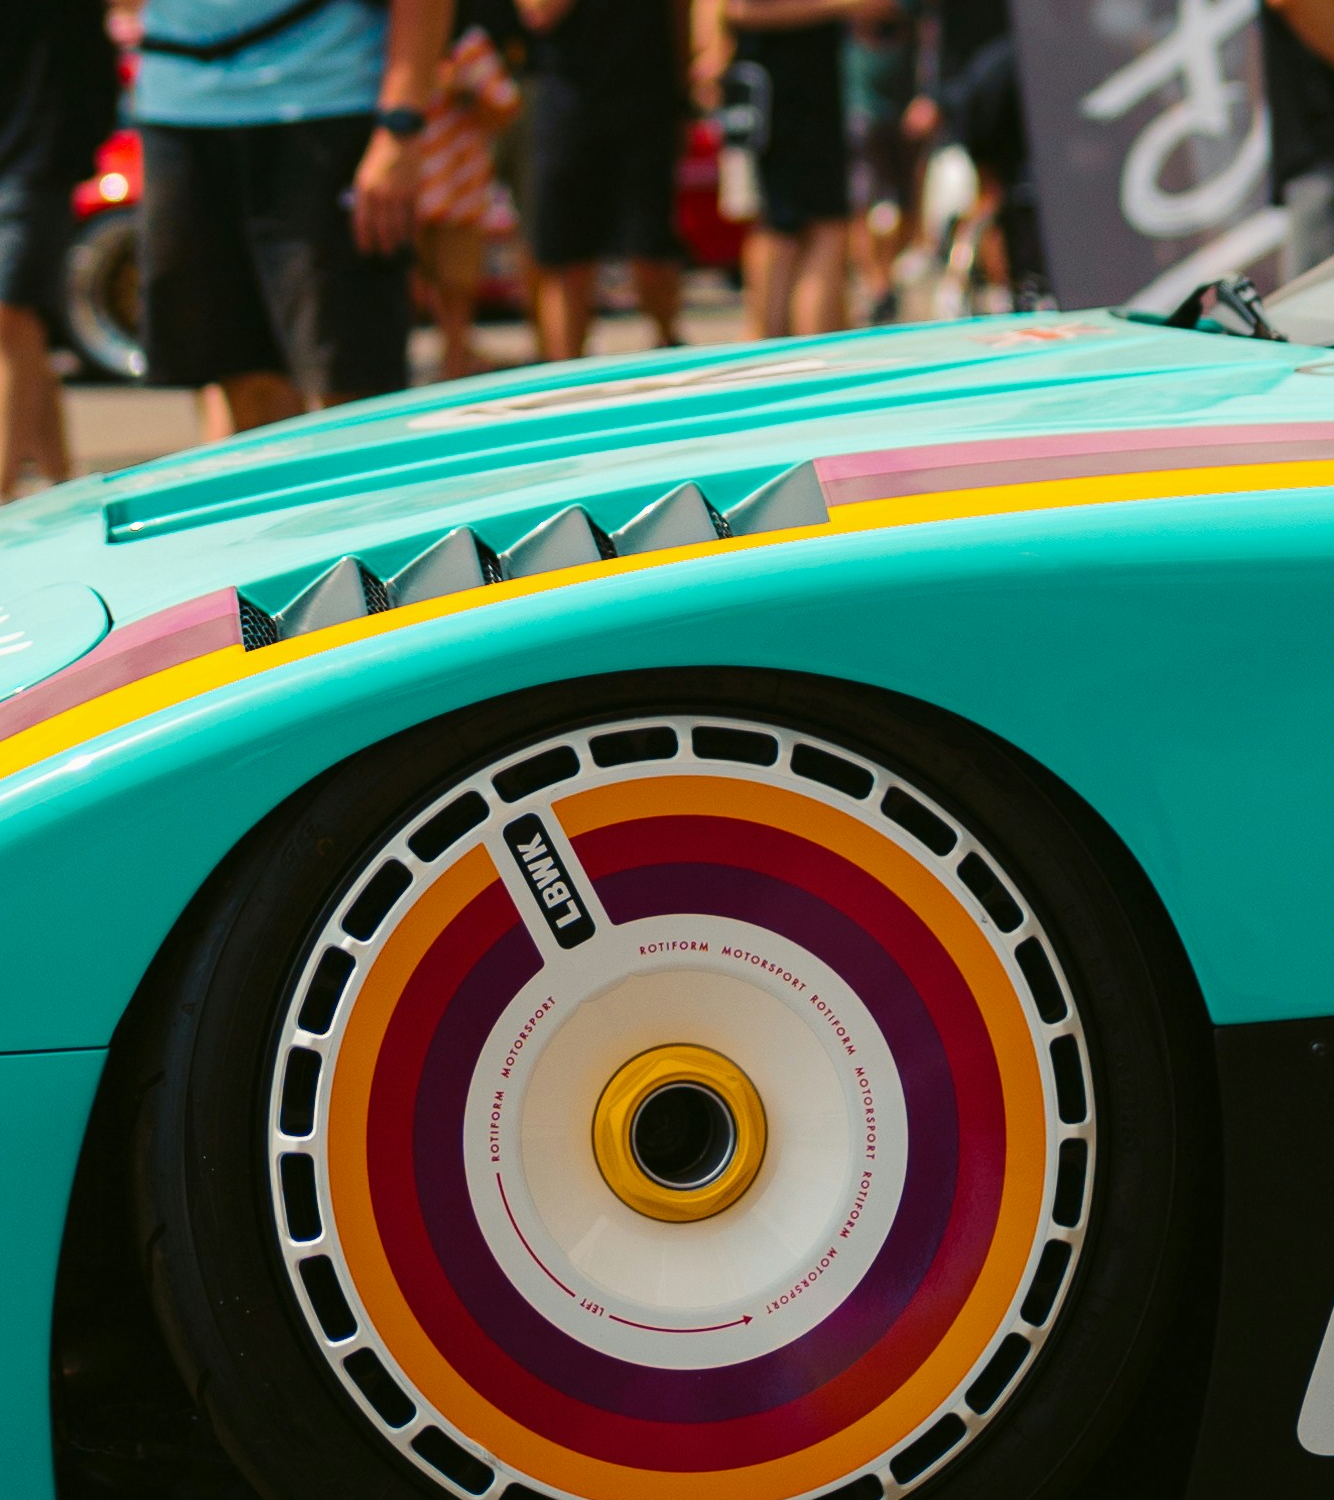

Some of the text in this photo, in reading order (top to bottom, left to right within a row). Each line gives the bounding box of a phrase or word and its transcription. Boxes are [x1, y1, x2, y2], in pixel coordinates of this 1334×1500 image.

[516, 831, 579, 931] LBWK
[490, 994, 557, 1163] ROTIFORM MOTORSPORT
[638, 939, 877, 1316] ROTIFORM MOTORSPORT ROTIFORM MOTORSPORT ROTIFORM MOTORSPORT
[578, 1296, 607, 1318] LEFT
